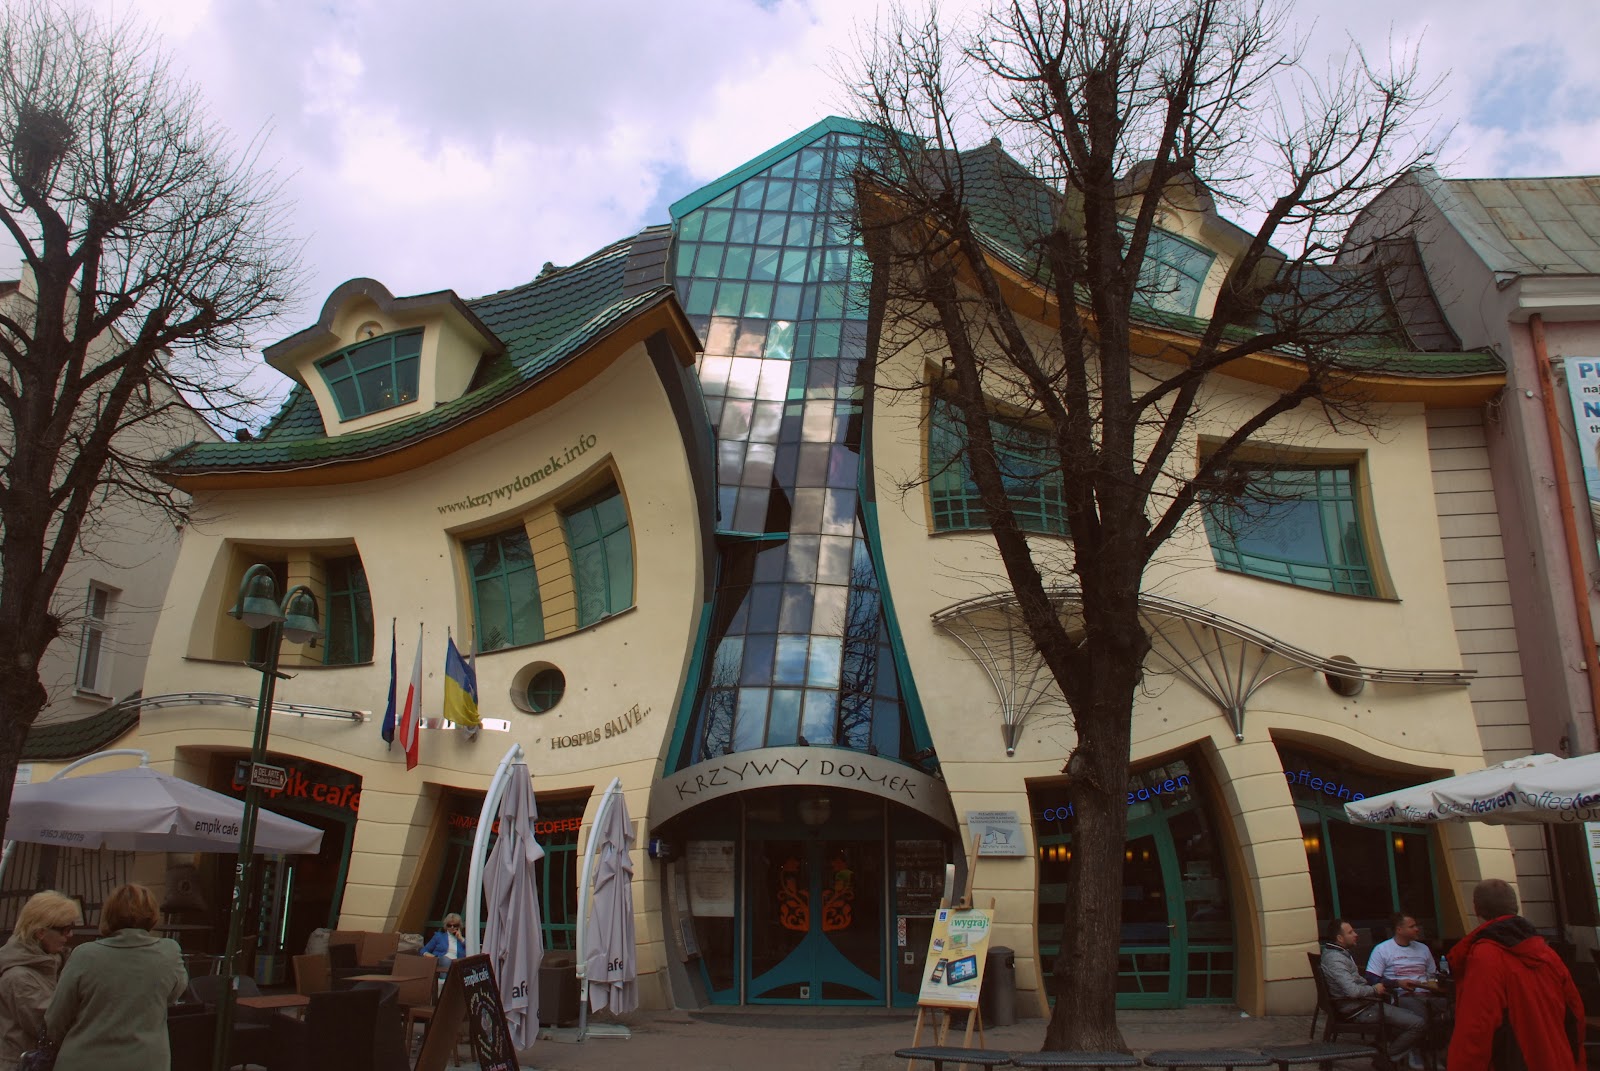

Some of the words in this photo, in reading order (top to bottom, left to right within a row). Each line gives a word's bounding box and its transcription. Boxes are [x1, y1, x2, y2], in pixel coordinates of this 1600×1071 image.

[437, 433, 597, 515] www.krzywydomek.info
[551, 728, 602, 750] HOSPES
[675, 757, 809, 801] KRZYWY
[820, 760, 917, 800] DOMEK
[1285, 769, 1365, 802] offeehe
[312, 783, 361, 812] cafe
[194, 818, 222, 835] empik
[222, 823, 239, 836] cafe
[608, 958, 623, 971] afe
